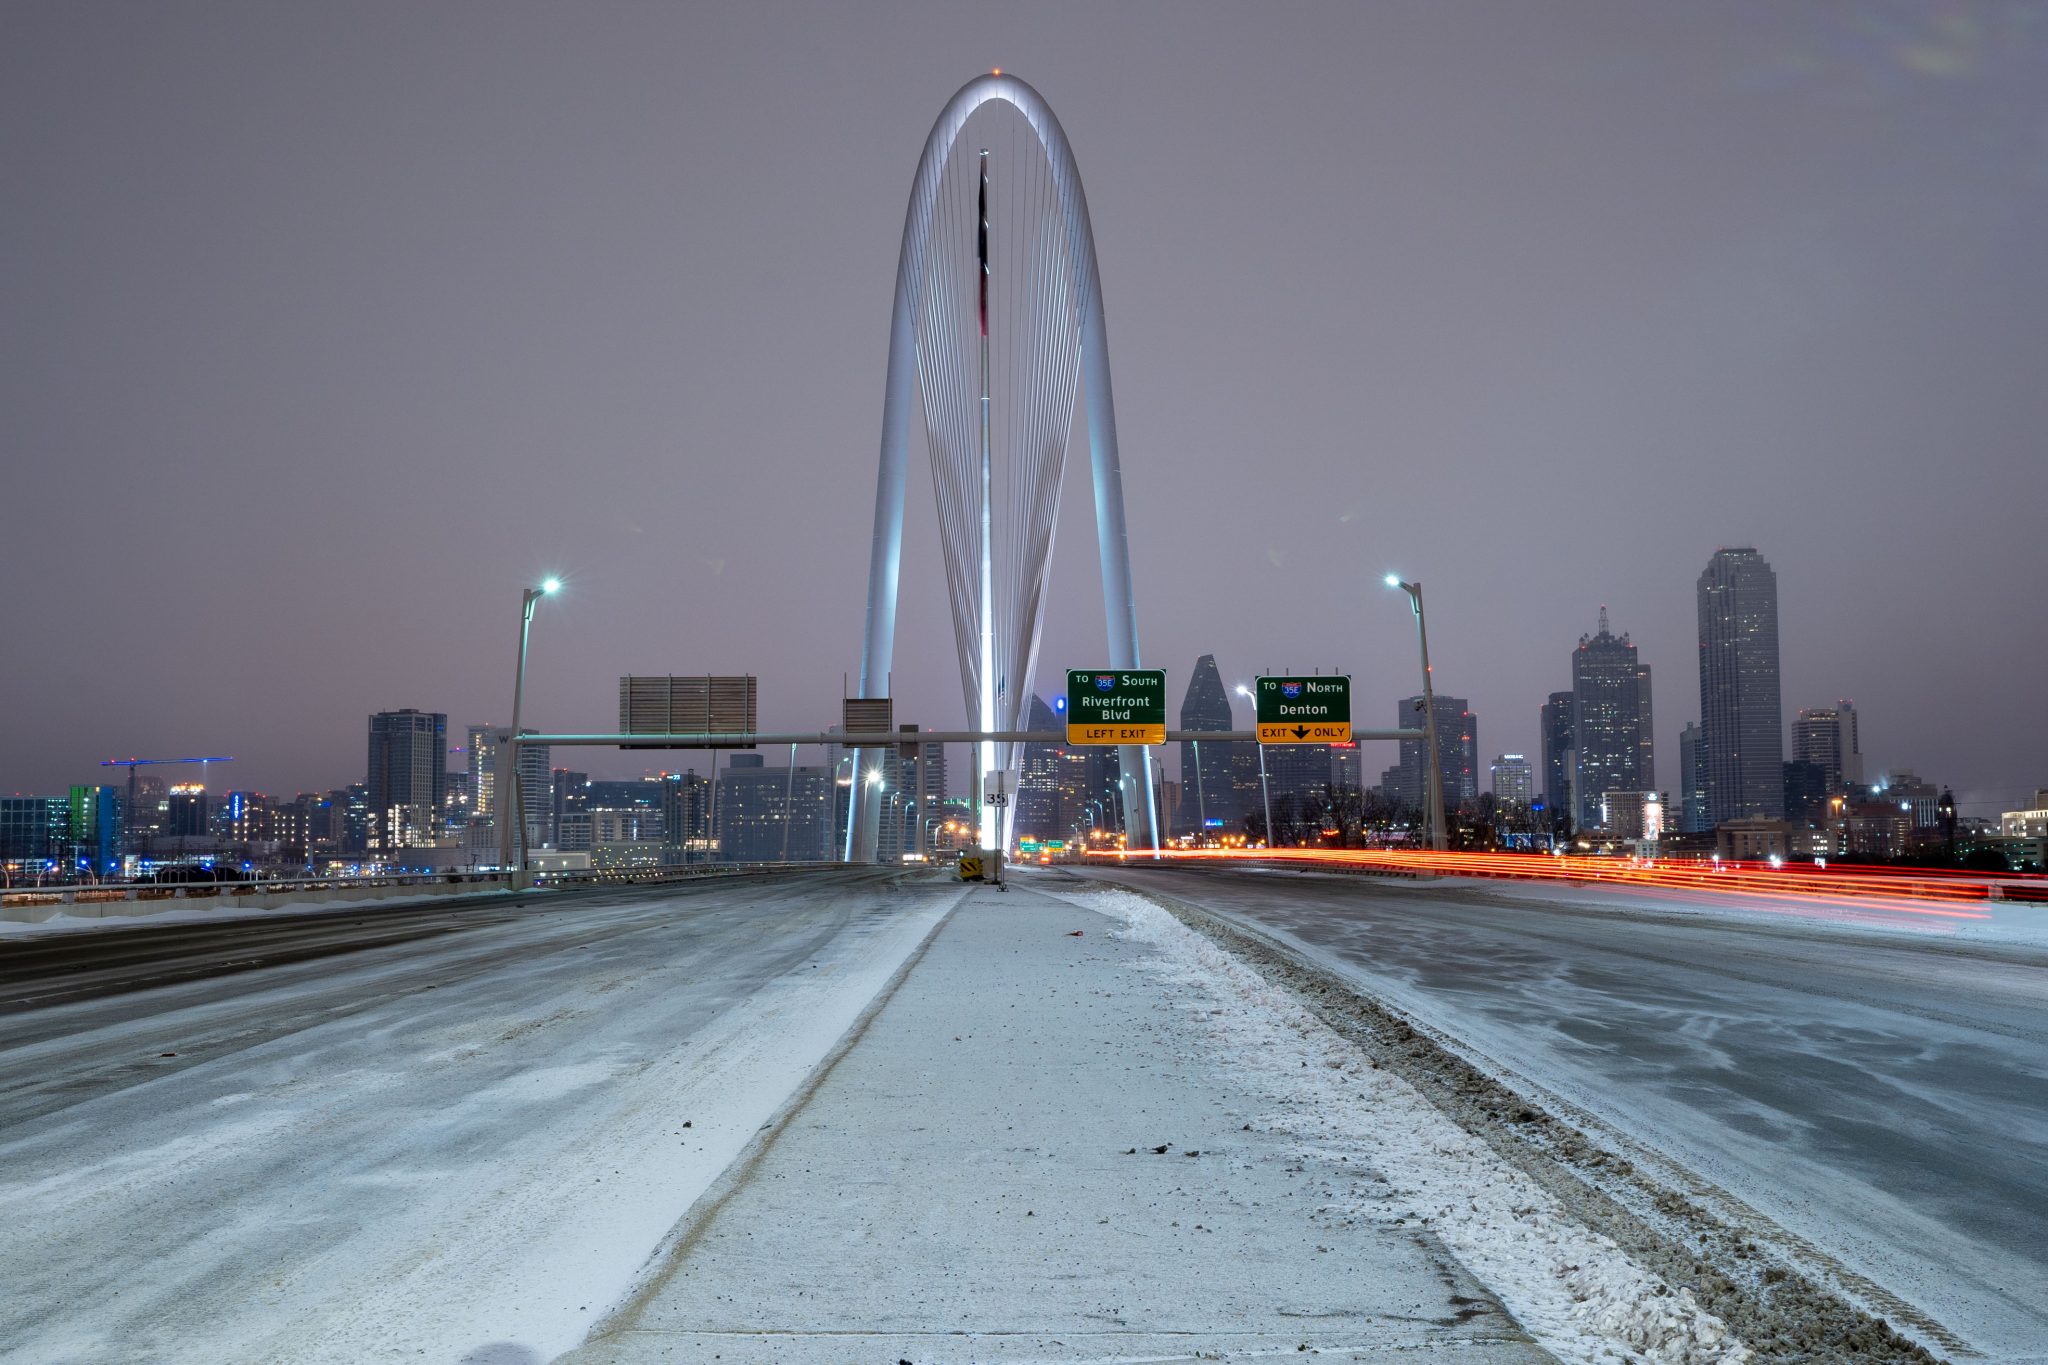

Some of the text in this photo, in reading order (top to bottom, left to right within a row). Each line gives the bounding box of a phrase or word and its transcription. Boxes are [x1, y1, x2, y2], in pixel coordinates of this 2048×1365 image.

[1076, 675, 1089, 683] TO
[1264, 682, 1277, 690] TO
[1082, 696, 1150, 707] Riverfront
[1102, 709, 1130, 720] Blvd
[1280, 705, 1328, 715] Denton
[1086, 729, 1146, 738] LEFT EXIT
[1262, 727, 1345, 737] EXIT ONLY
[498, 735, 509, 744] W
[987, 793, 1005, 804] 35
